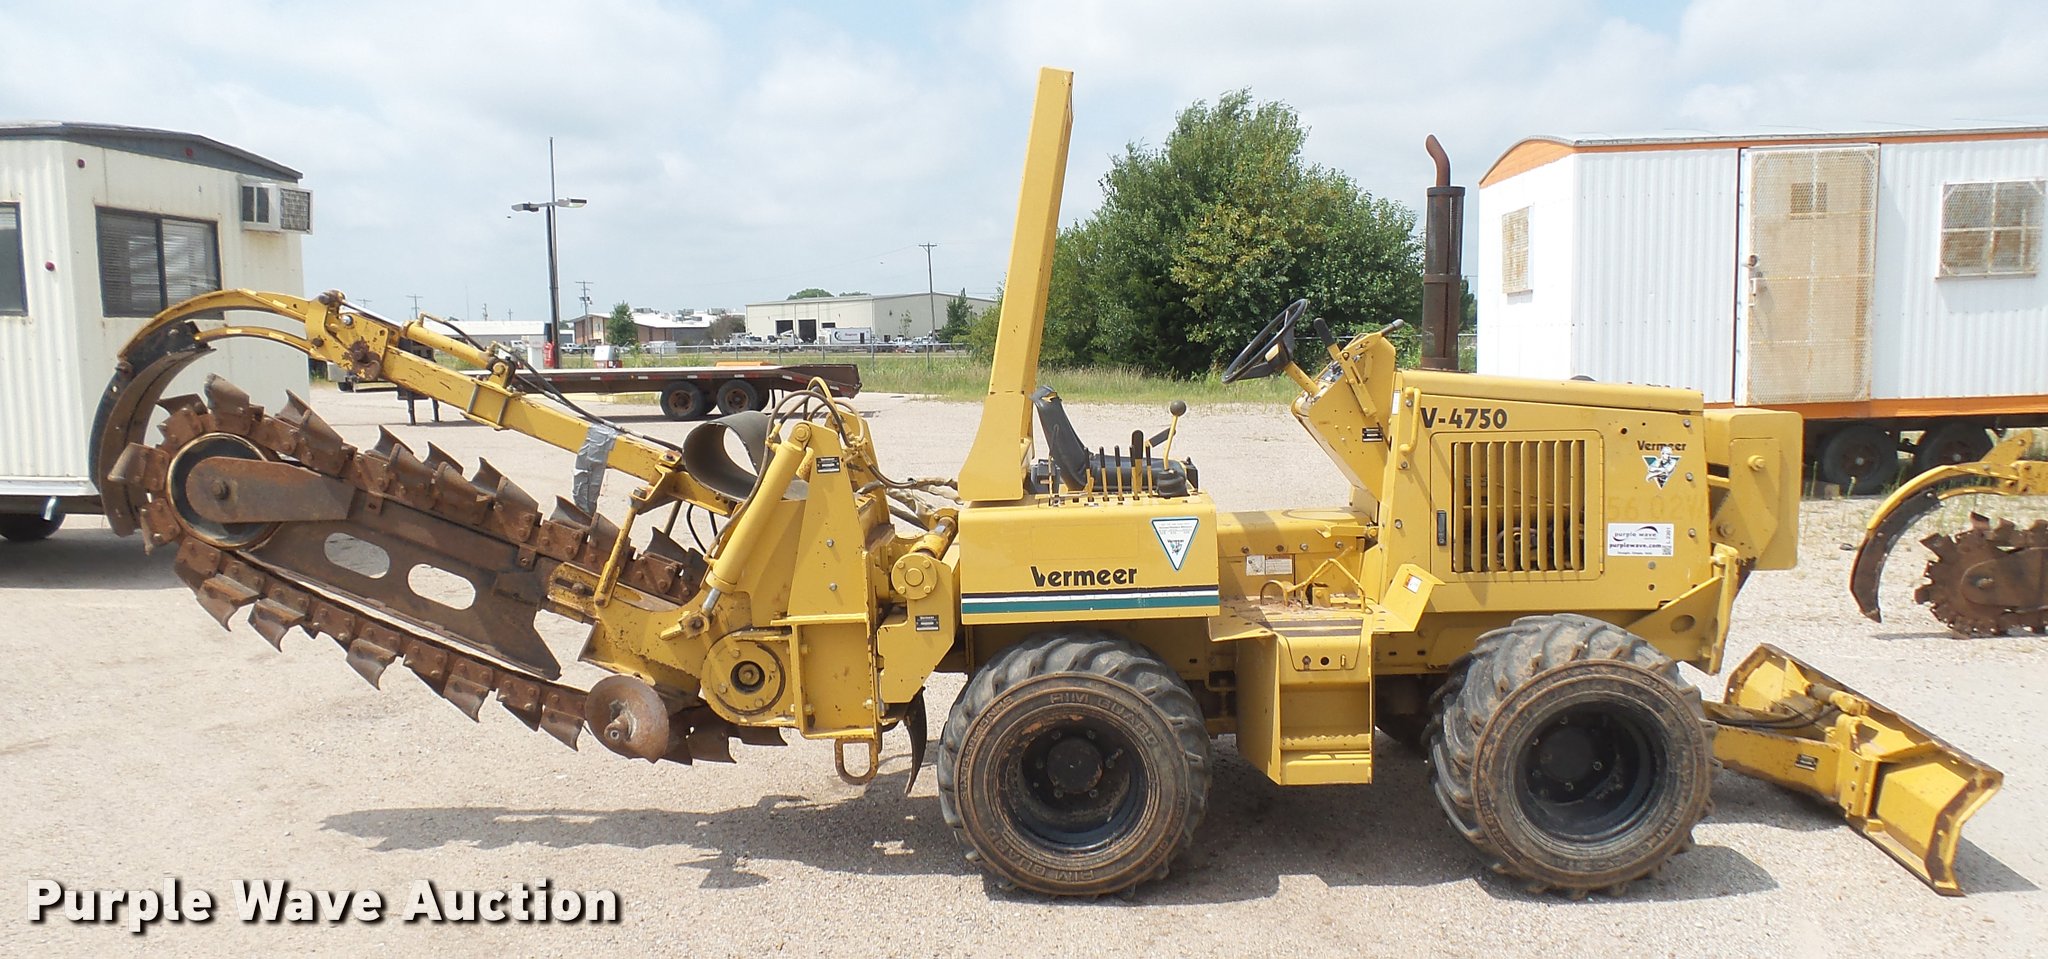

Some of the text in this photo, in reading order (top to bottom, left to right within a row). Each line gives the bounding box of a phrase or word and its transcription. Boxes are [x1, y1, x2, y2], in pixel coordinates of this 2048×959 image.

[1420, 407, 1508, 430] V-4750
[1637, 440, 1687, 451] Vermeer
[1614, 531, 1637, 539] purple
[1030, 566, 1138, 587] Vermeer
[1050, 691, 1089, 703] RIM
